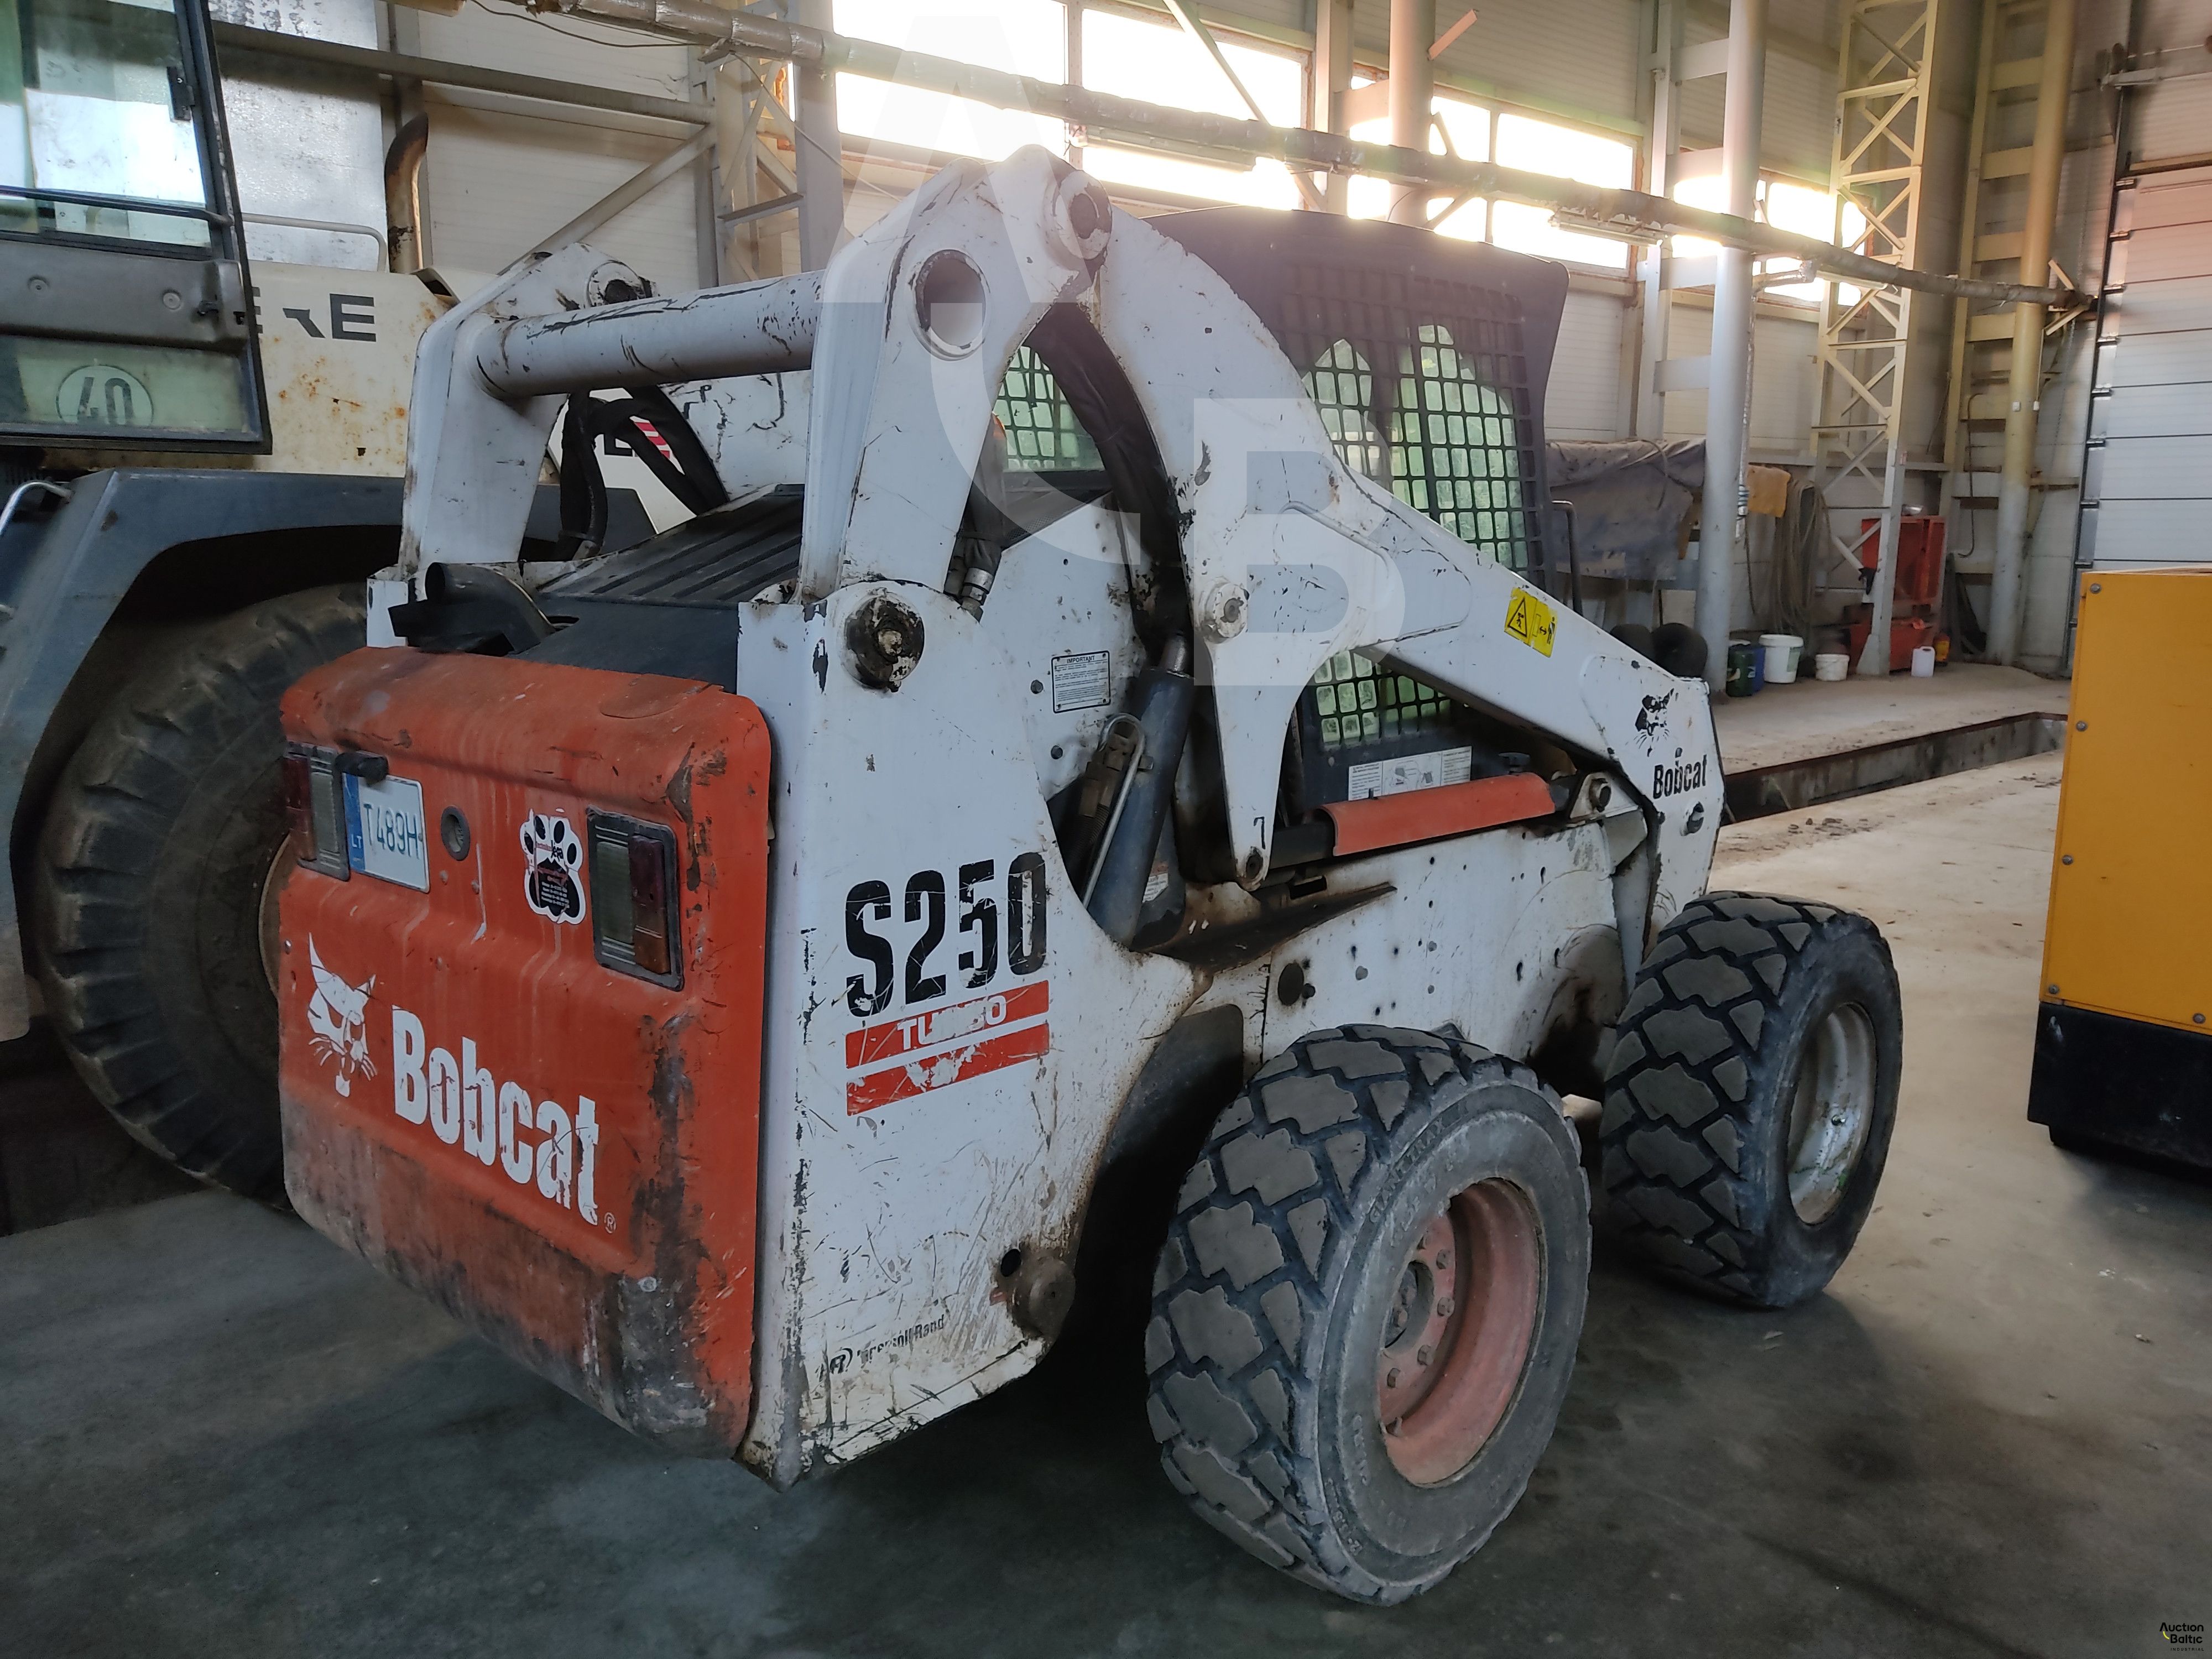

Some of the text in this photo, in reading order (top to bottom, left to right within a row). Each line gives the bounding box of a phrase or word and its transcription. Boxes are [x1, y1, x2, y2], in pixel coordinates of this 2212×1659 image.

[1067, 655, 1095, 664] IMPORTANT
[1653, 754, 1707, 799] Bobcat
[351, 833, 363, 849] LT
[363, 802, 420, 859] T489H
[846, 852, 1047, 1018] S250
[392, 1004, 599, 1226] Bobcat
